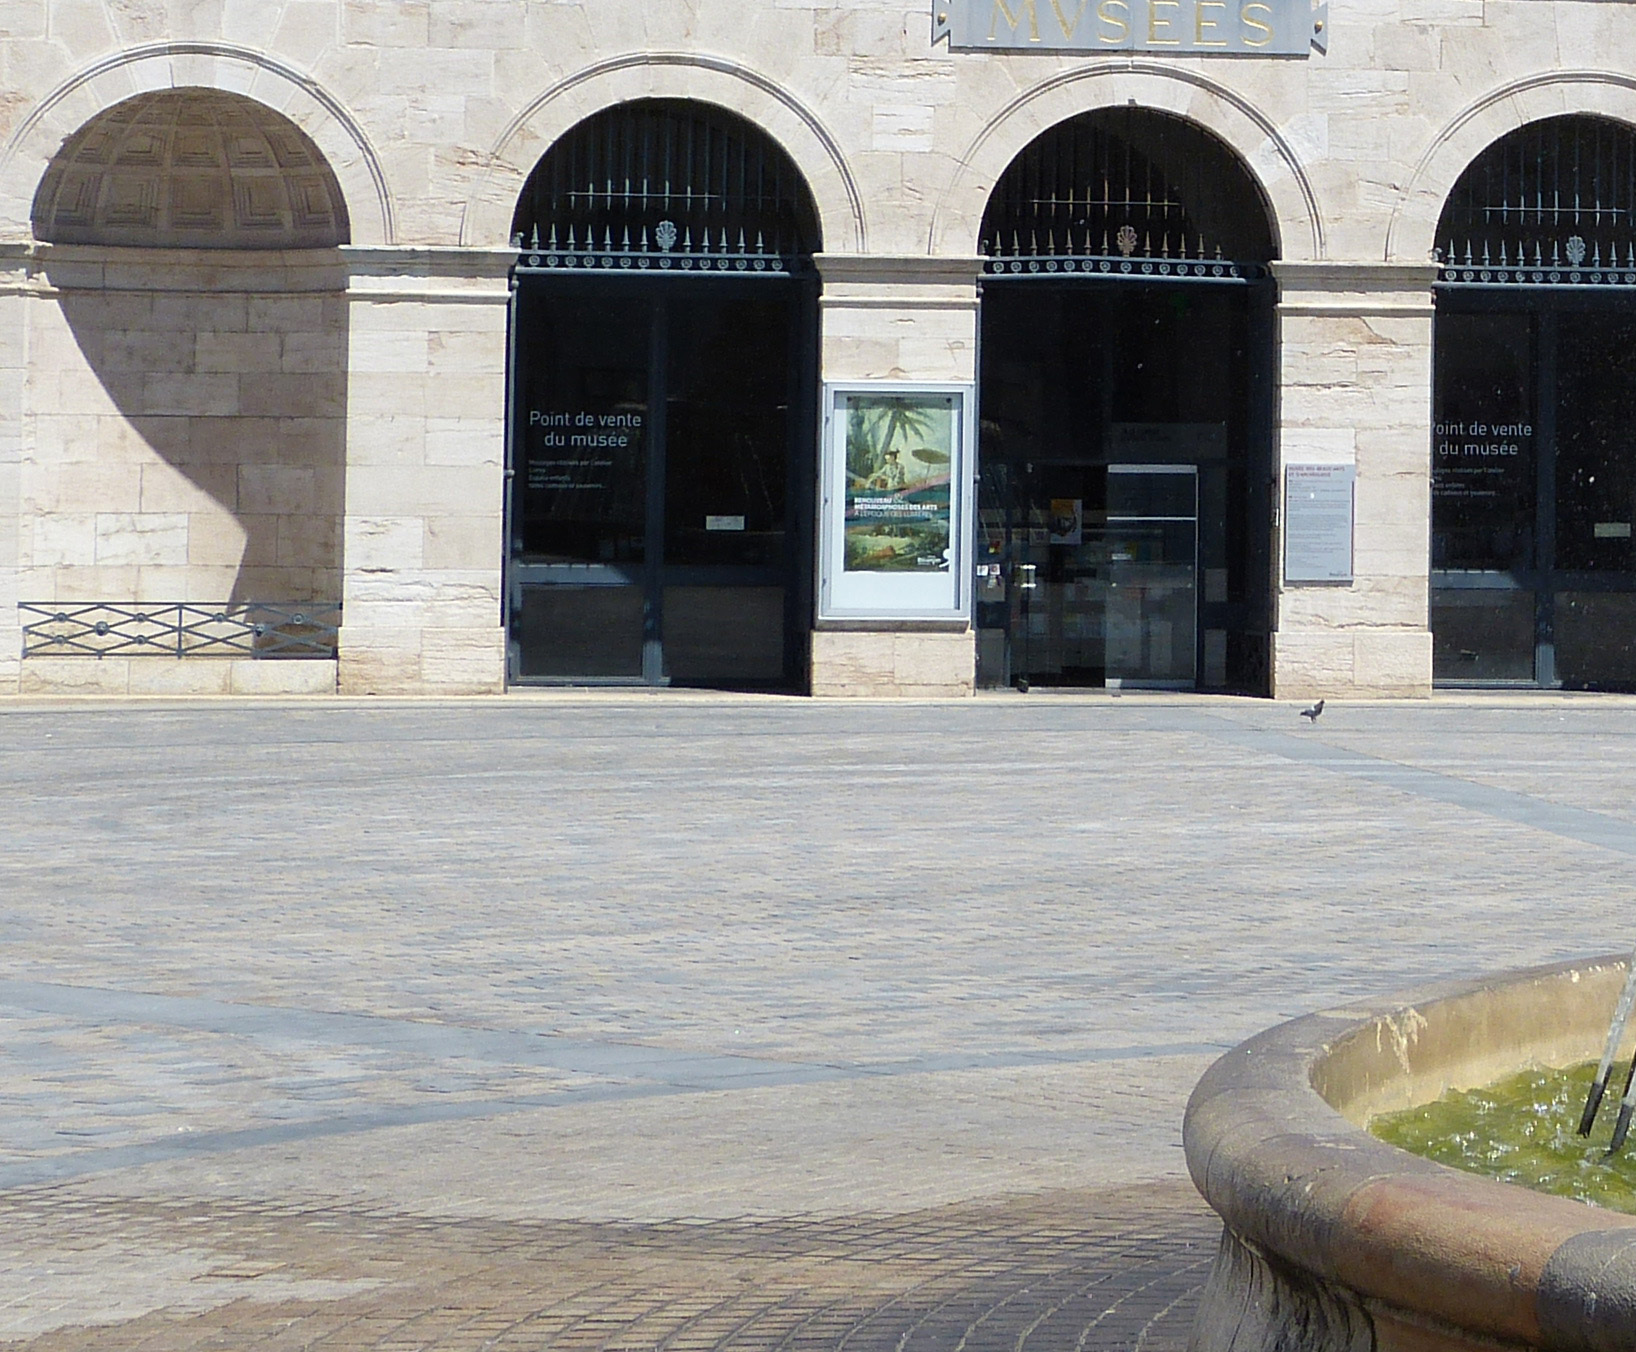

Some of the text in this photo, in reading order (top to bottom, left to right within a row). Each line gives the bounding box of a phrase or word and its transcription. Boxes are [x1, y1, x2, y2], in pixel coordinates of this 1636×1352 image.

[529, 410, 642, 427] Point de vente
[1432, 421, 1533, 436] oint de vente
[544, 432, 628, 447] du musée
[1439, 440, 1519, 456] du musée
